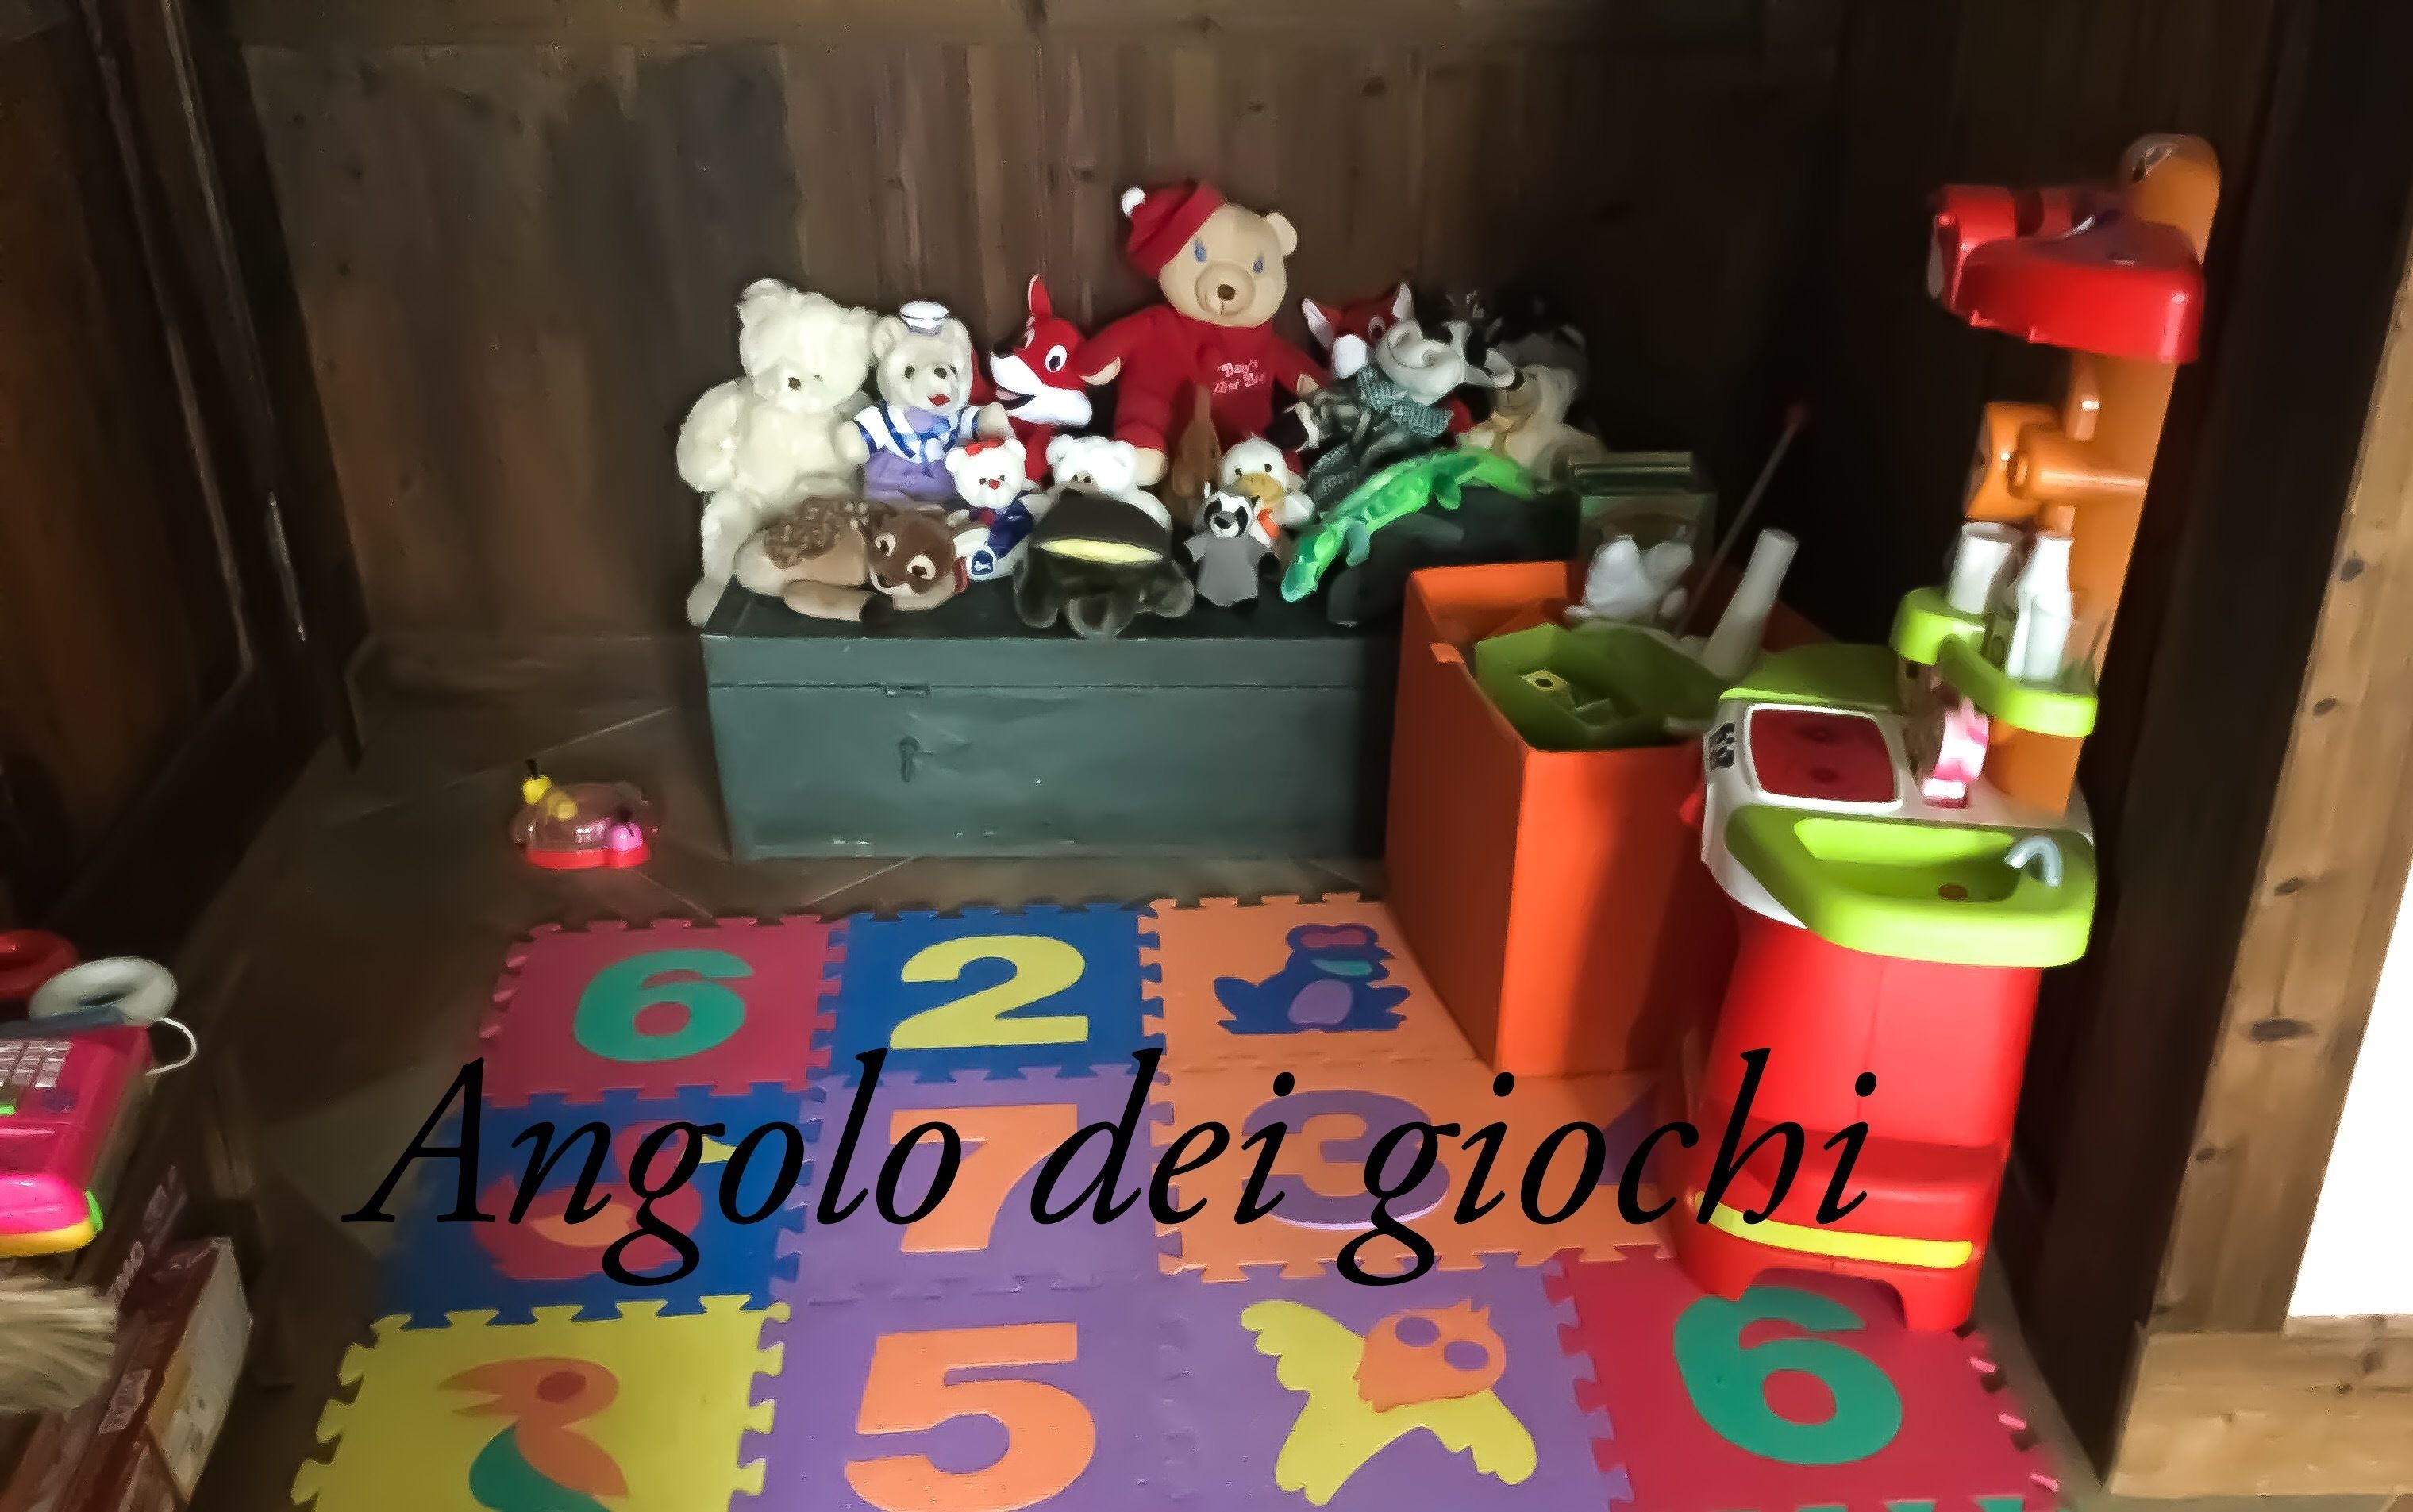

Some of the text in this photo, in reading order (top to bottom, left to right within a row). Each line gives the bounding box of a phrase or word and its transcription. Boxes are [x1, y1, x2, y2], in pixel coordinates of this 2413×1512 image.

[573, 933, 1090, 1062] 6 2
[887, 1088, 1451, 1255] 7 3
[845, 1285, 1903, 1512] 5 6
